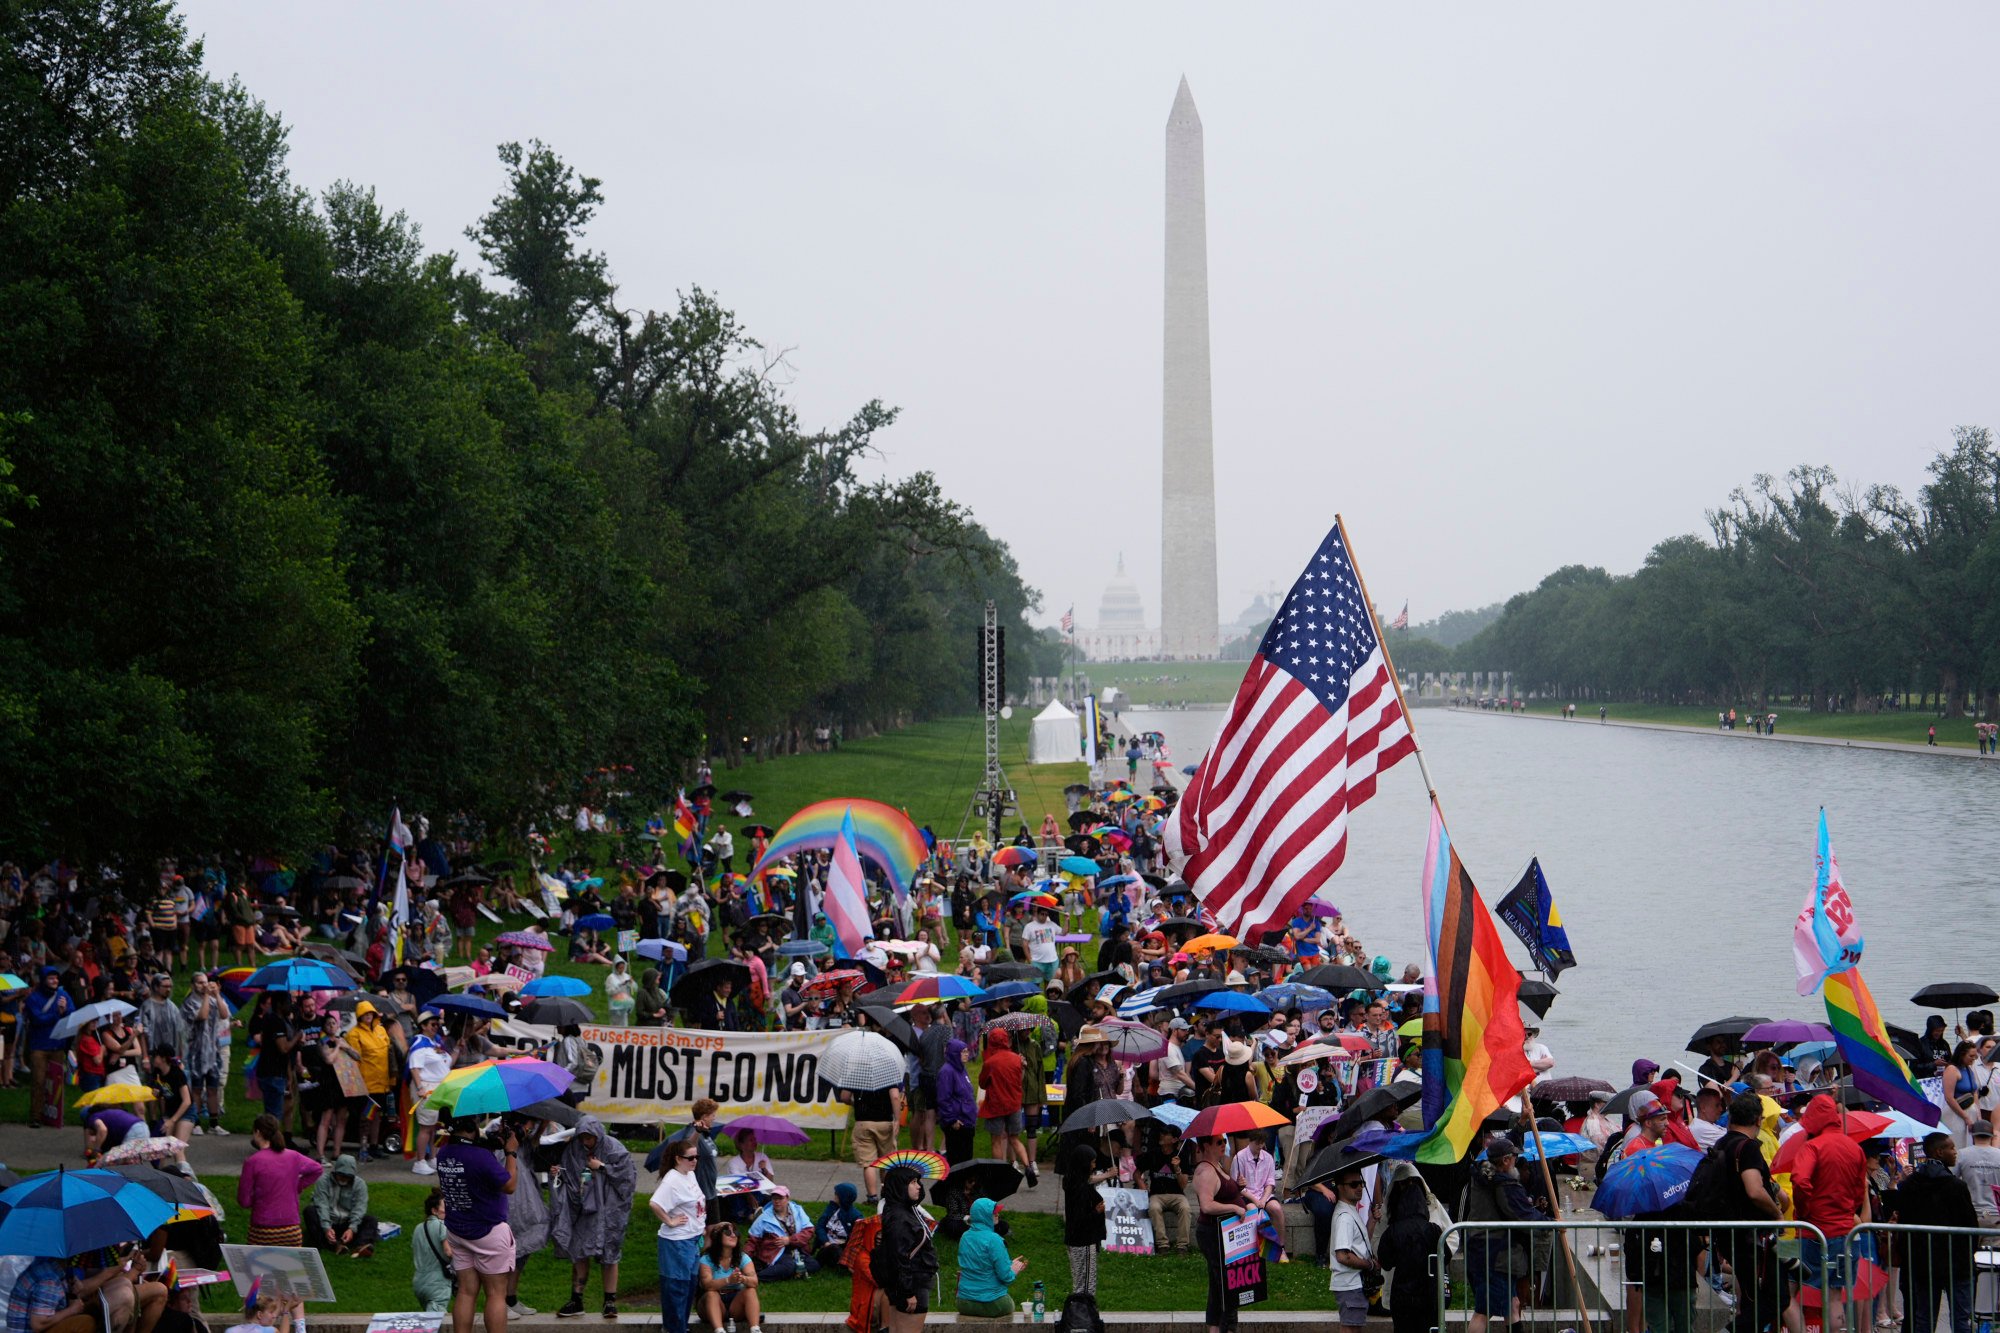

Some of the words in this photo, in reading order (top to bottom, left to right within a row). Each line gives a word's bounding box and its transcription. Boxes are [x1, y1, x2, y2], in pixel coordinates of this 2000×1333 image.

[1502, 908, 1528, 937] MEANS
[582, 1028, 724, 1051] efusefascism.org
[610, 1043, 702, 1101] MUST
[708, 1050, 757, 1103] GO
[437, 1165, 465, 1173] PRODUCER
[1116, 1215, 1136, 1225] THE
[1112, 1226, 1143, 1235] RIGHT
[1234, 1222, 1254, 1234] PROTECT
[1235, 1230, 1250, 1240] TRANS
[1120, 1236, 1136, 1245] TO
[1235, 1237, 1251, 1247] YOUTH
[1226, 1262, 1261, 1290] BACK
